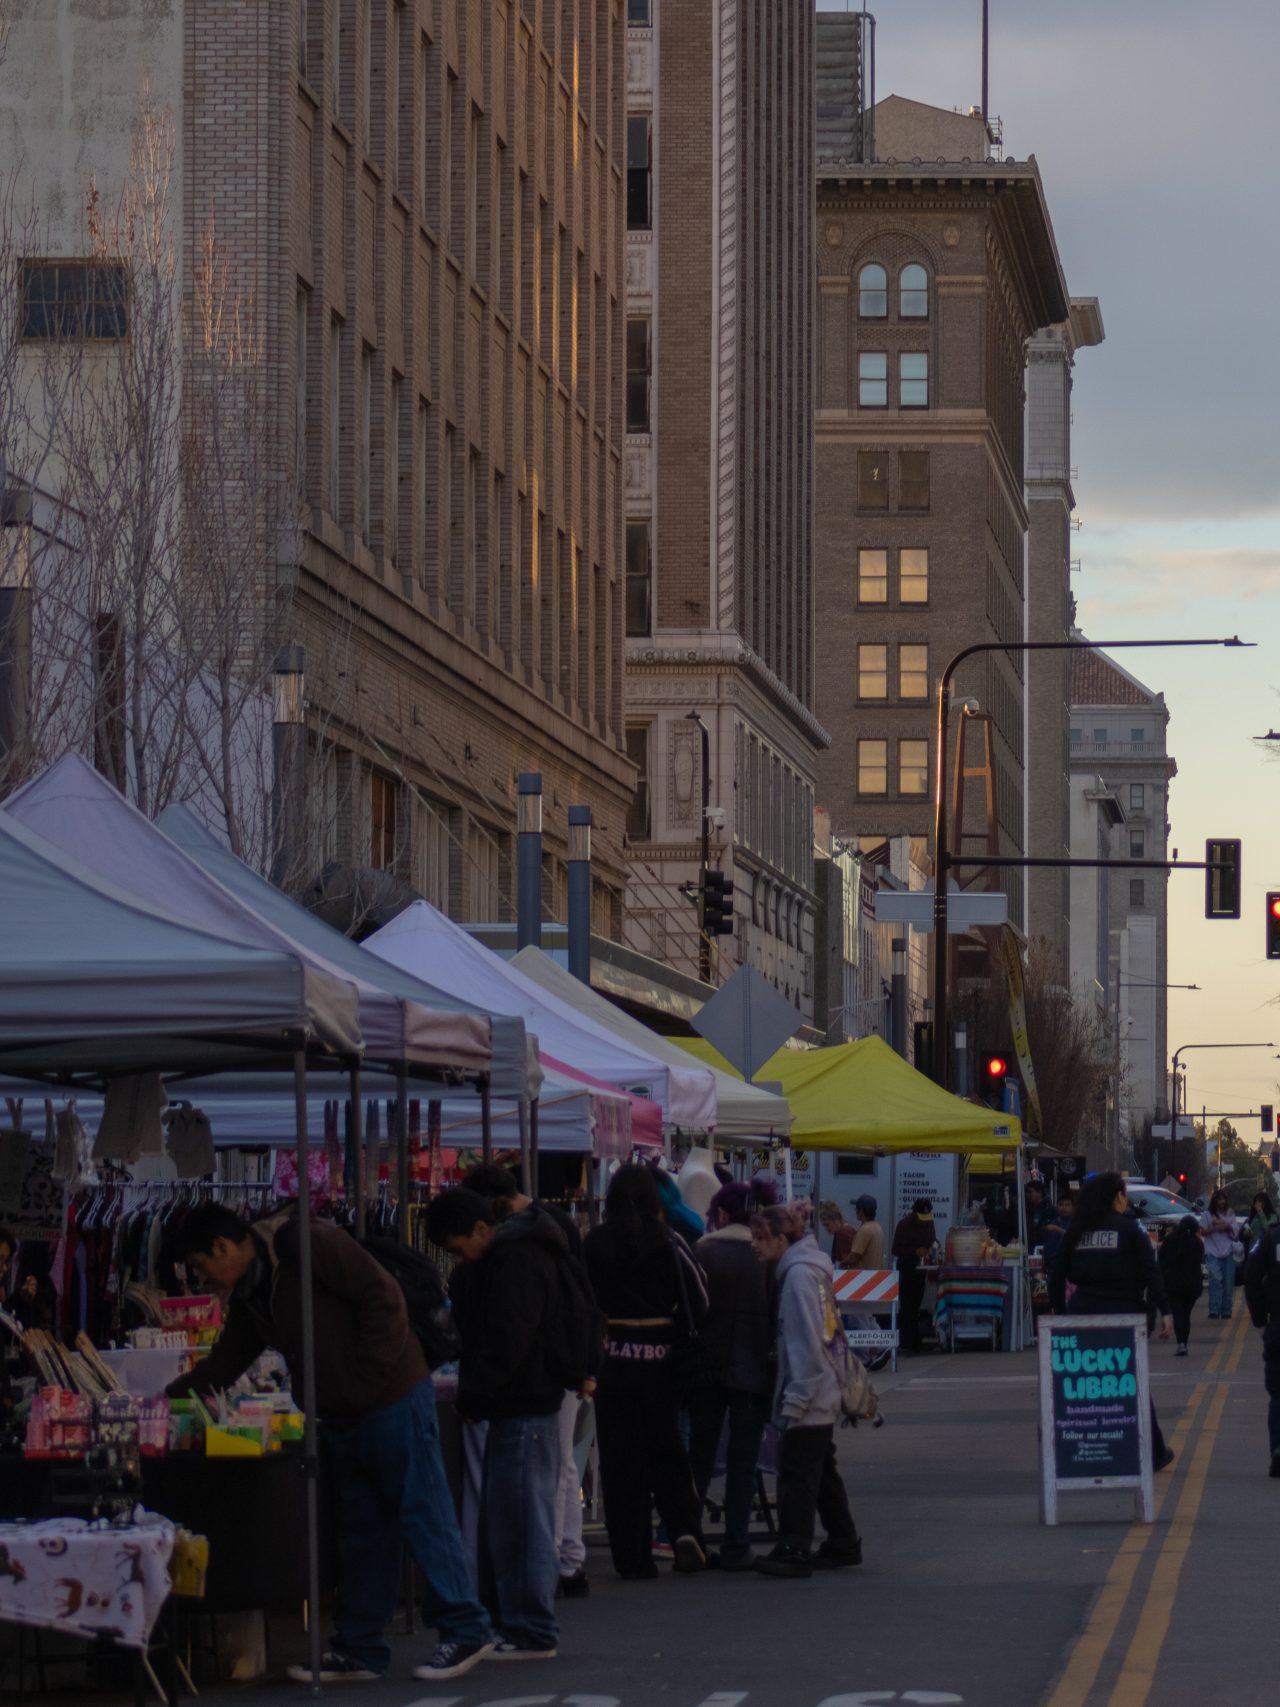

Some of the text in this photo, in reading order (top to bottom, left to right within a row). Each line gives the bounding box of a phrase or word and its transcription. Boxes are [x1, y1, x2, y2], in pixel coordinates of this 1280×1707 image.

[1080, 1231, 1113, 1247] OLICE
[604, 1339, 671, 1360] LAYBO
[1051, 1335, 1077, 1350] THE
[1051, 1347, 1131, 1373] LUCKY
[1063, 1373, 1137, 1399] LIBRA
[1066, 1404, 1125, 1414] handmade
